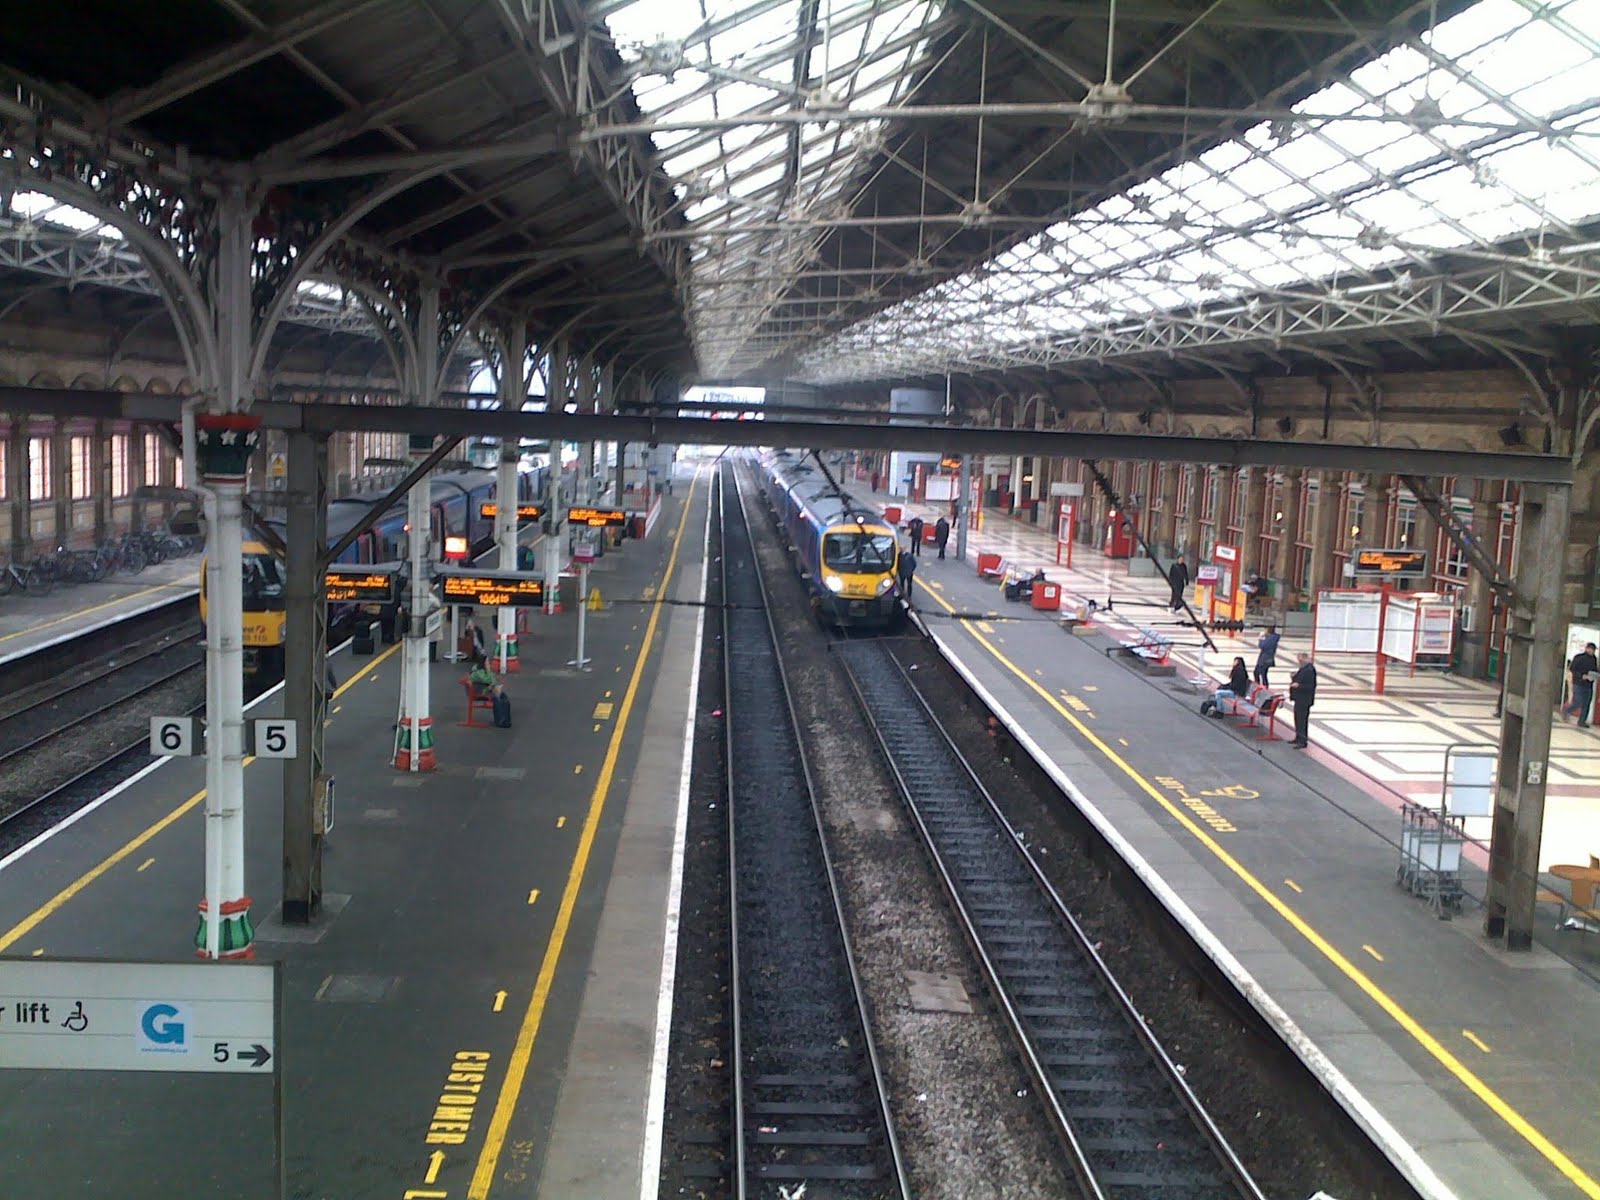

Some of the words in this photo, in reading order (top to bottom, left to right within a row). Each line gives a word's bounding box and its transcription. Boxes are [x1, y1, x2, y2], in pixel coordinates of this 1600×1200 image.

[160, 723, 181, 750] 6
[266, 726, 286, 752] 5
[16, 1003, 50, 1024] lift
[213, 1043, 230, 1062] 5
[424, 1051, 491, 1144] CUSTOMER
